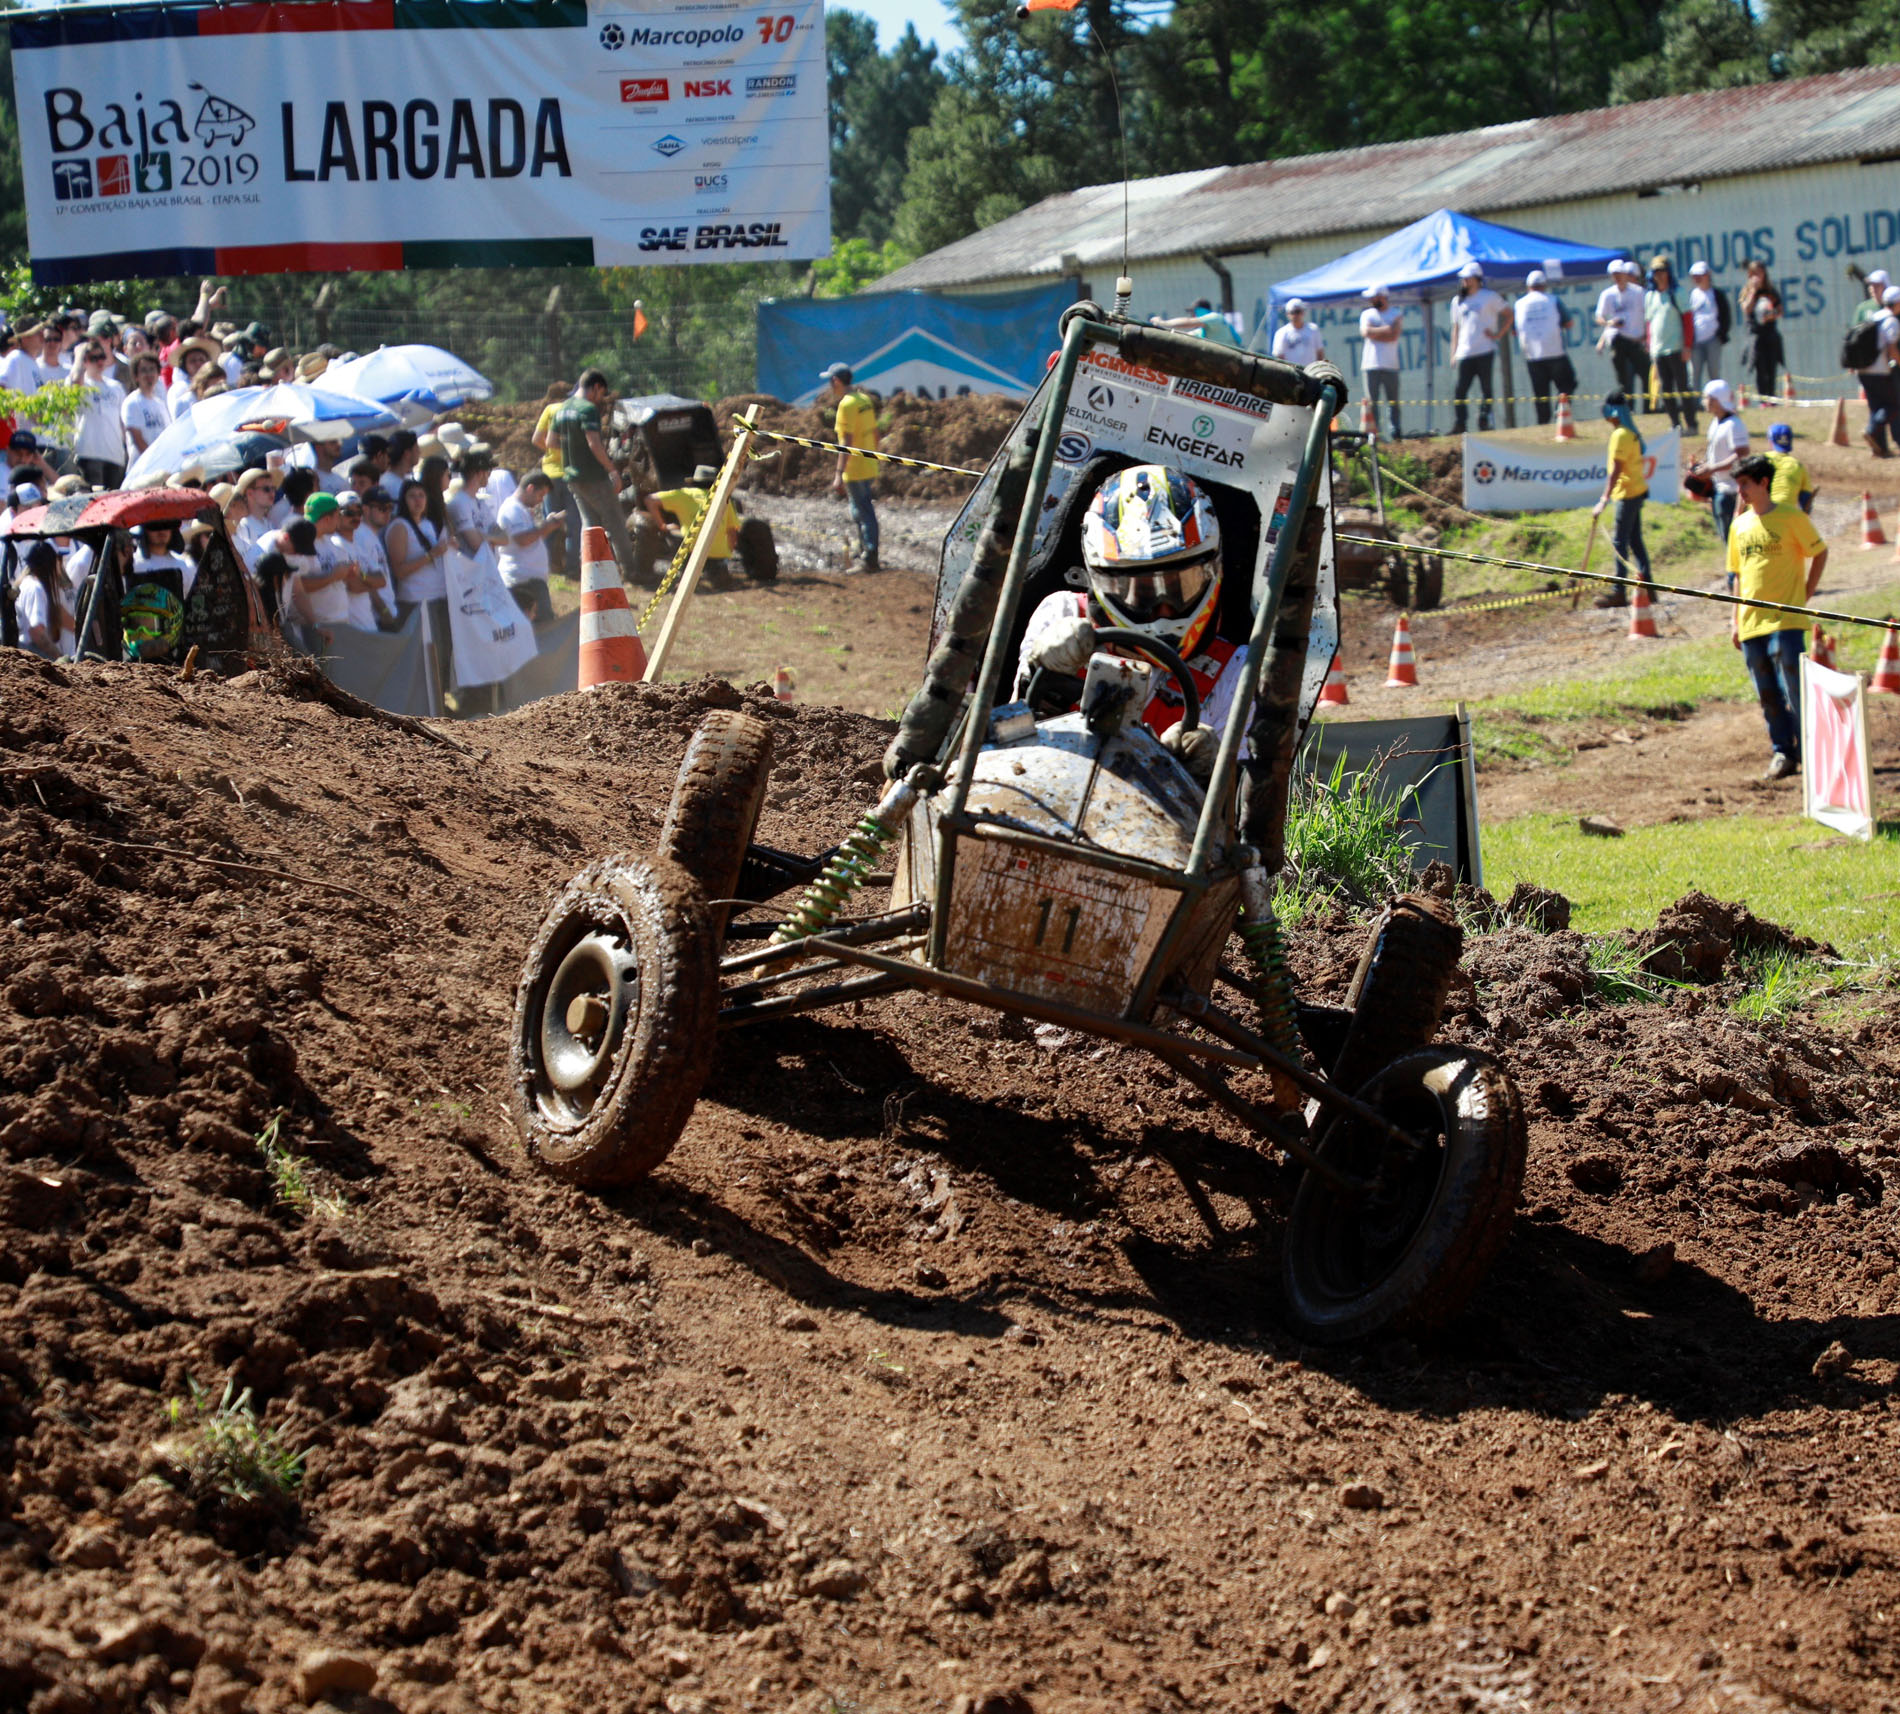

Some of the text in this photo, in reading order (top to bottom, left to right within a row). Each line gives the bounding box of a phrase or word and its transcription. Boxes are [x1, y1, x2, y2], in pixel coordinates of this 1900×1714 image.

[631, 24, 744, 48] Marcopolo
[756, 14, 795, 44] 70
[684, 79, 733, 98] NSK
[747, 77, 794, 89] RANDON
[44, 86, 190, 171] Baja
[281, 97, 573, 182] LARGADA
[701, 135, 759, 147] voestalpine
[180, 153, 259, 186] 2019
[704, 174, 728, 187] UCS
[638, 222, 788, 251] SAE BRASIL
[1175, 377, 1274, 415] HARDWARE
[1146, 426, 1245, 469] ENGEFAR
[1502, 465, 1608, 484] Marcopolo
[1034, 898, 1082, 954] 11
